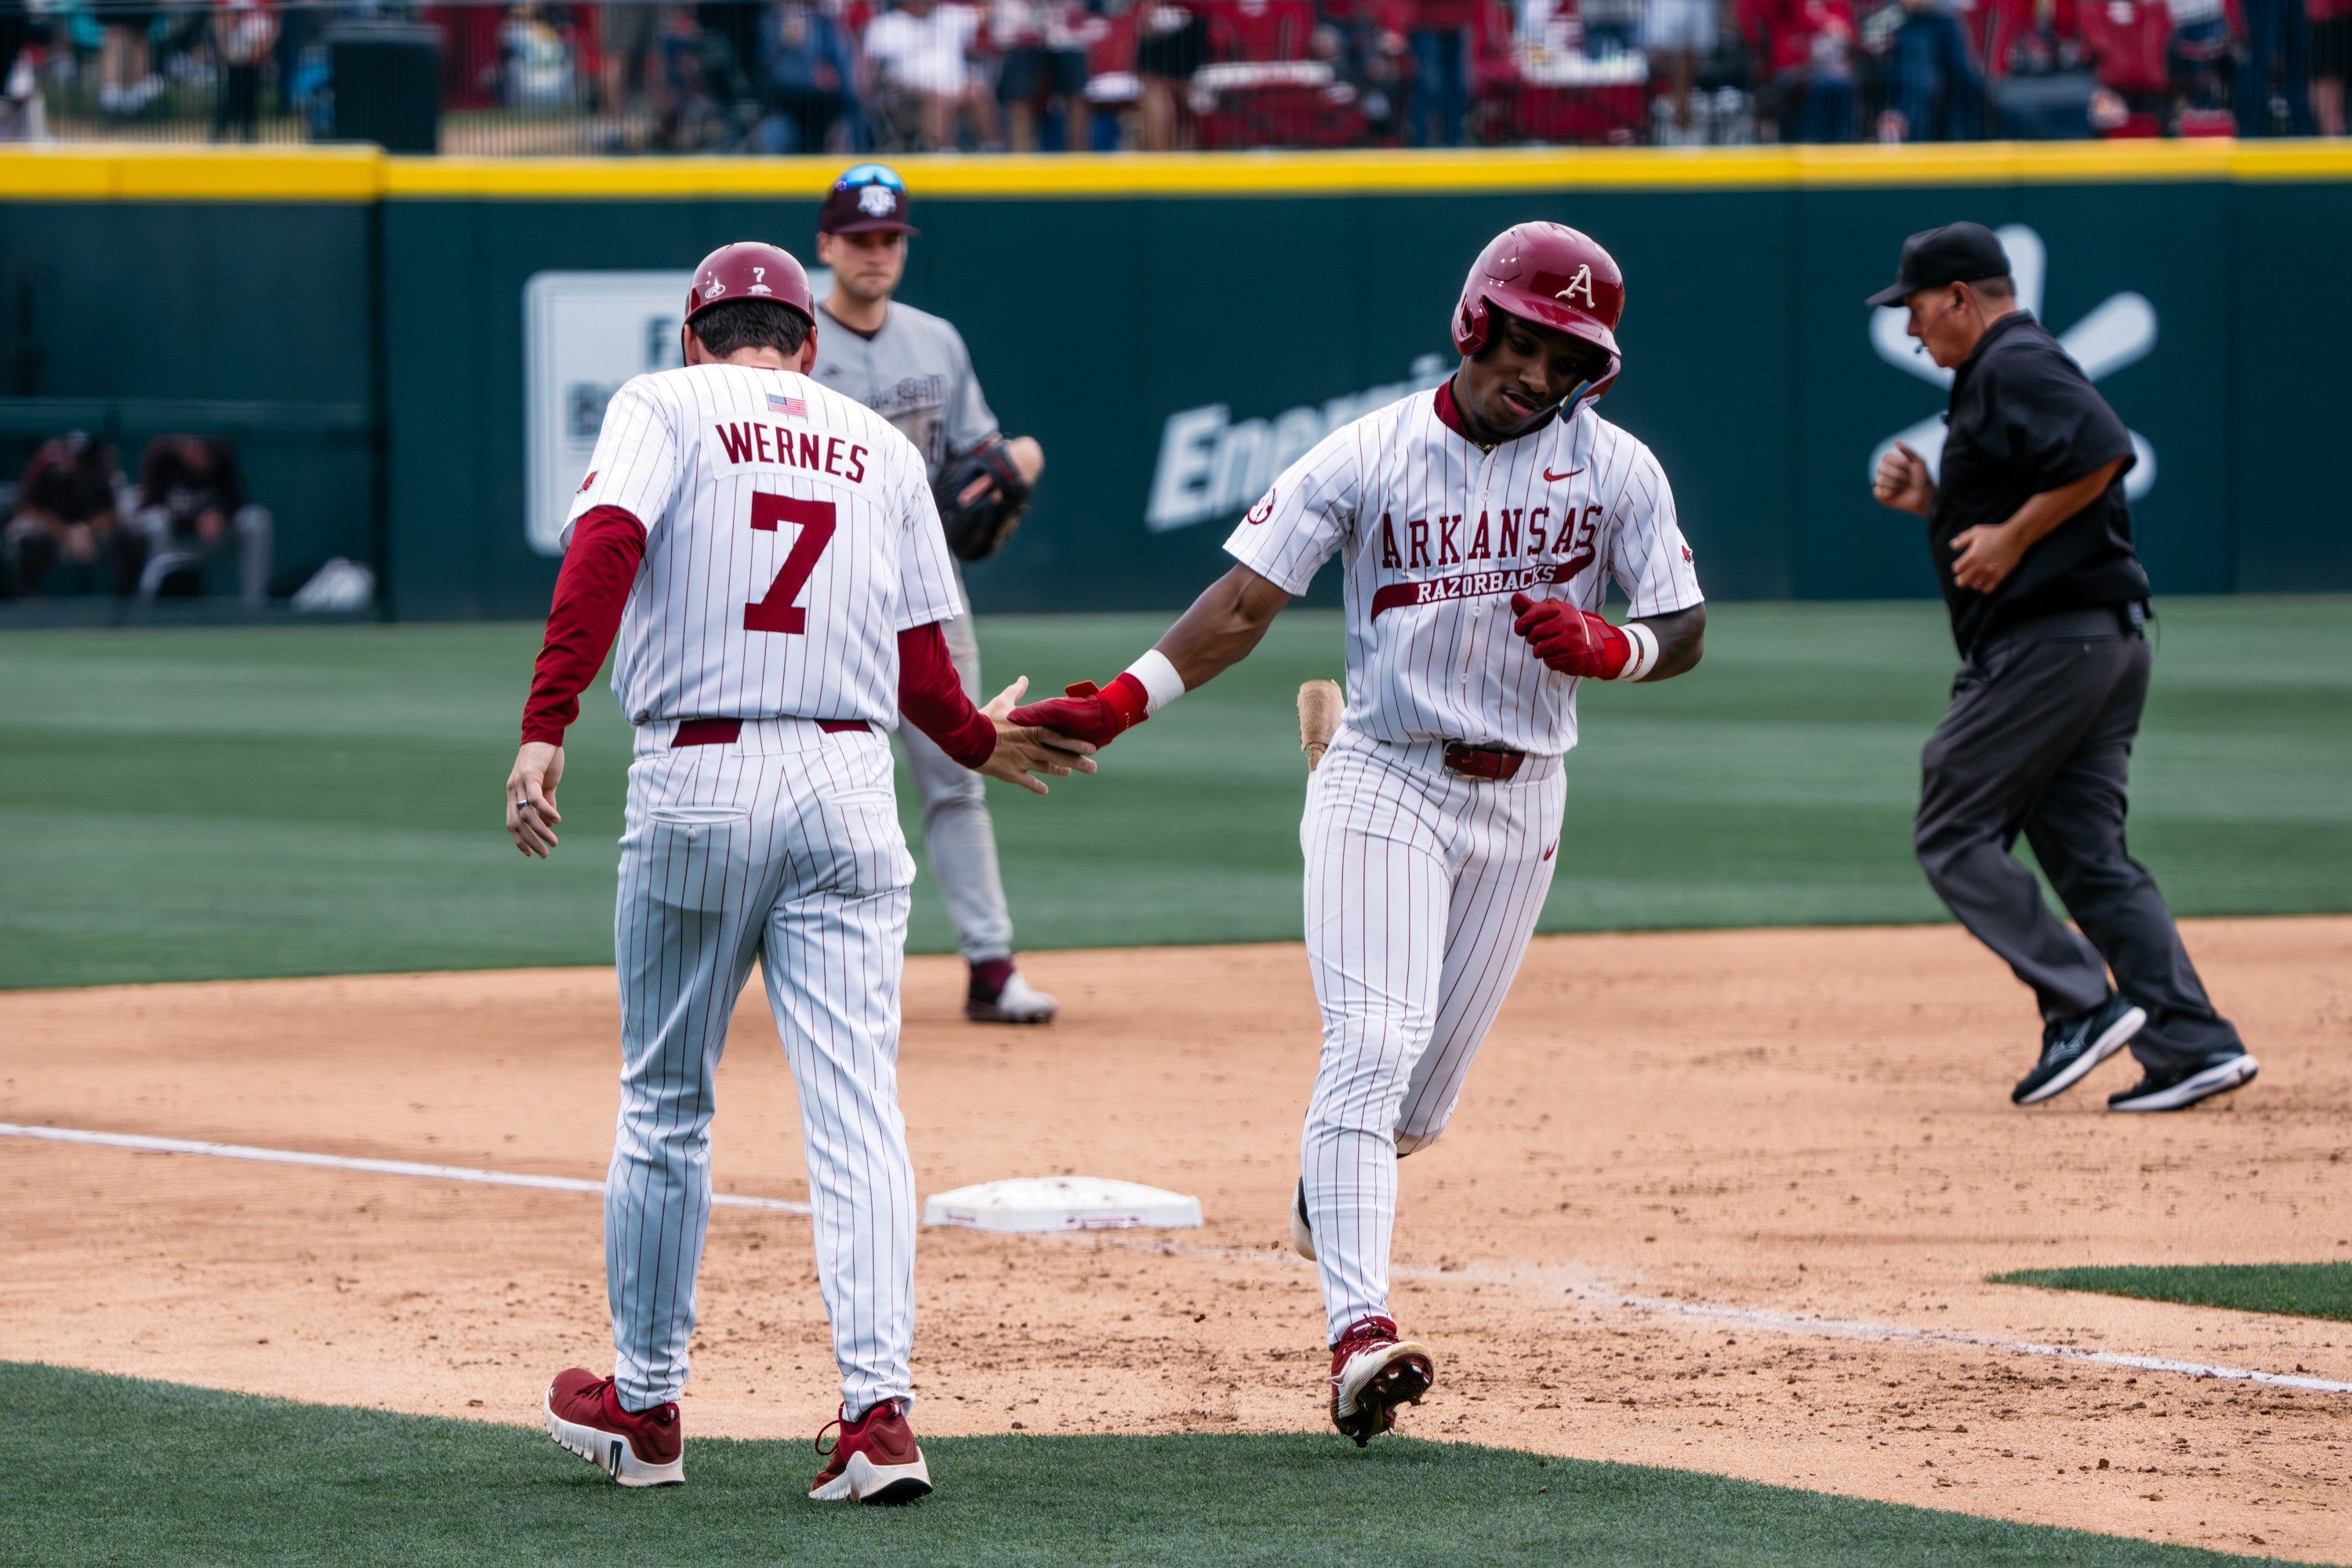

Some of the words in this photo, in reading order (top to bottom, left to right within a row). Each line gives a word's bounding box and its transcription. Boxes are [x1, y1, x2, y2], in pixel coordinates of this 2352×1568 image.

[753, 267, 765, 283] 7
[1555, 263, 1595, 309] A
[715, 421, 869, 485] WERNES
[743, 490, 837, 635] 7
[1382, 506, 1604, 569] ARKANSAS
[1417, 565, 1556, 604] RAZORBACKS
